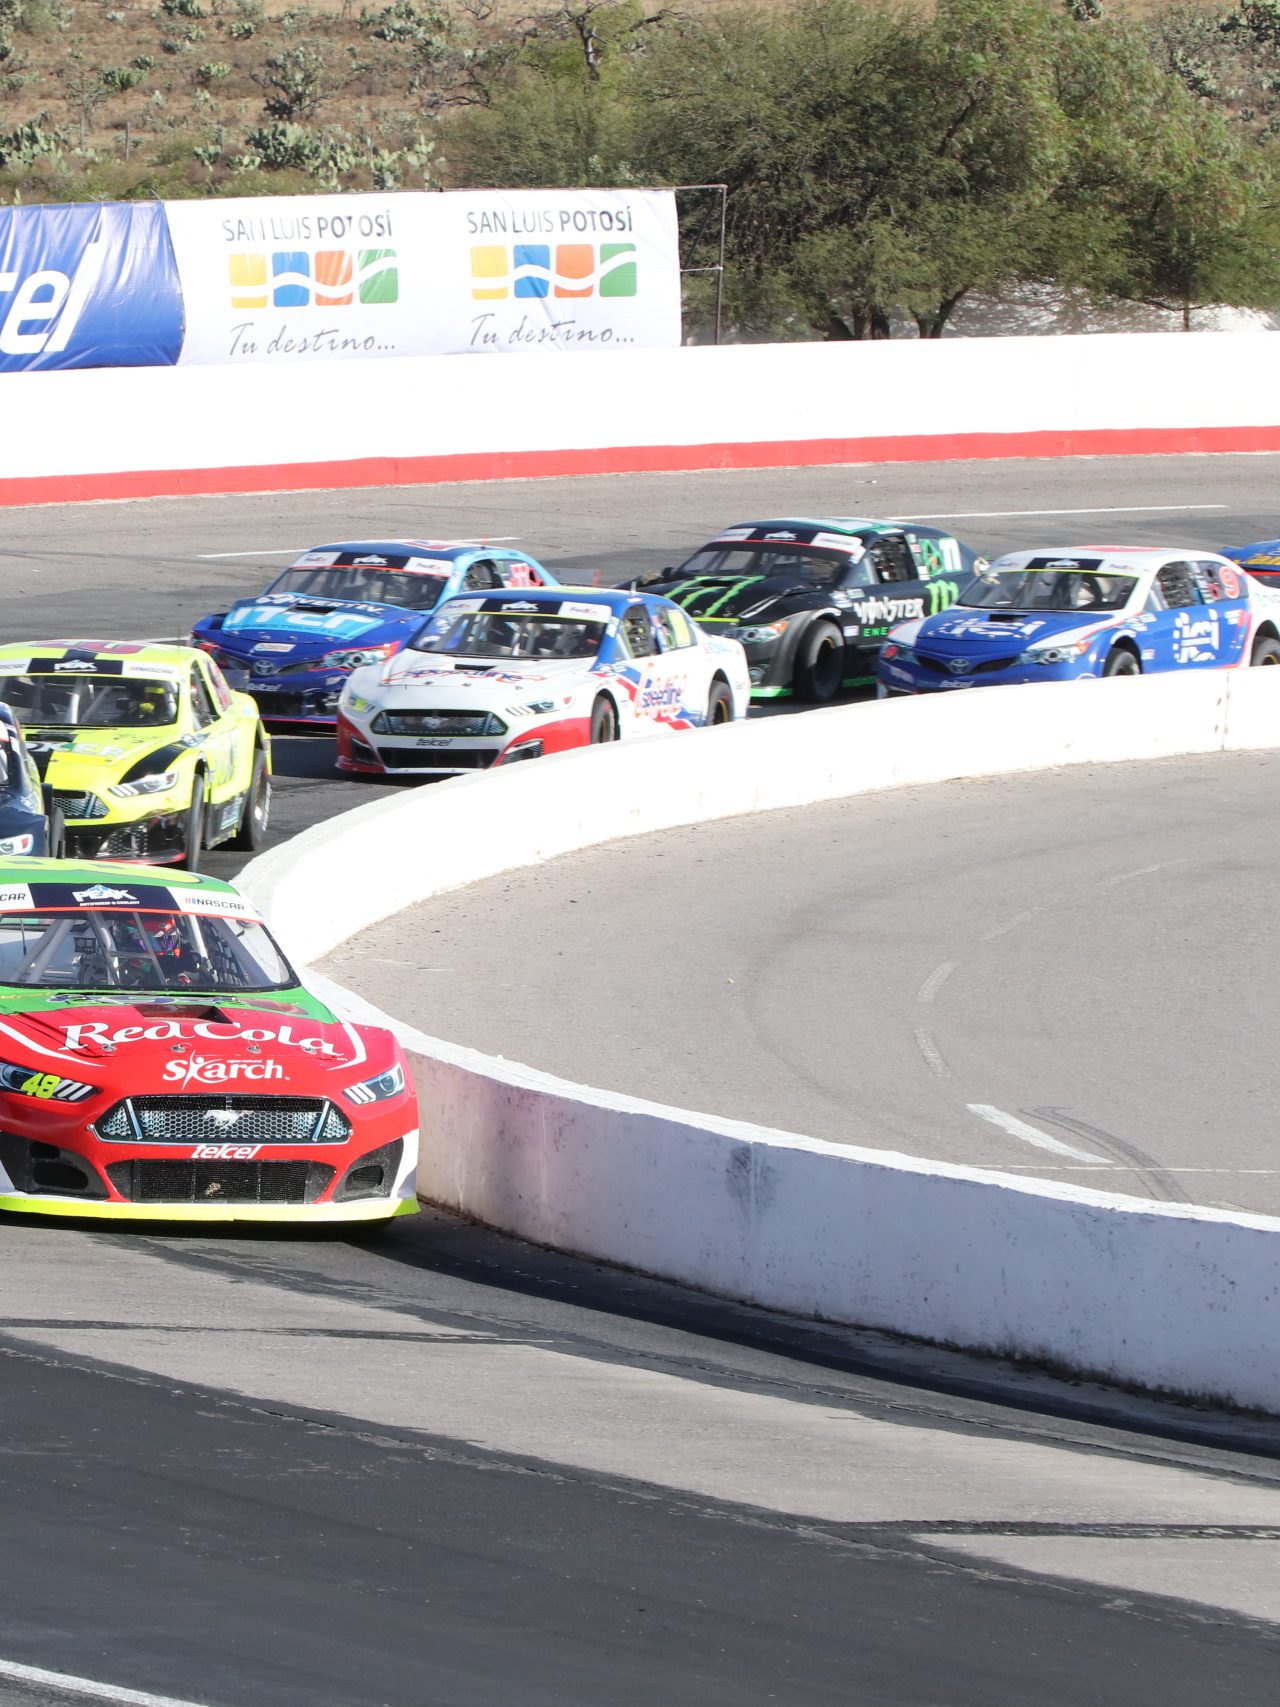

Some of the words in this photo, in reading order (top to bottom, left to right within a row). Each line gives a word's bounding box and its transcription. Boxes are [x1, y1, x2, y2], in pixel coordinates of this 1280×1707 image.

[467, 211, 508, 234] SAN
[512, 210, 554, 233] LUIS
[559, 206, 633, 232] POTOSÍ
[229, 322, 257, 356] Tu
[470, 312, 500, 346] Tu
[863, 627, 890, 637] ENE
[415, 738, 453, 747] telcel
[71, 884, 138, 903] PEAK
[195, 897, 246, 911] NASCAR
[56, 1022, 192, 1052] Red
[193, 1021, 345, 1058] Cola
[20, 1072, 61, 1099] 48
[191, 1143, 263, 1160] telcel
